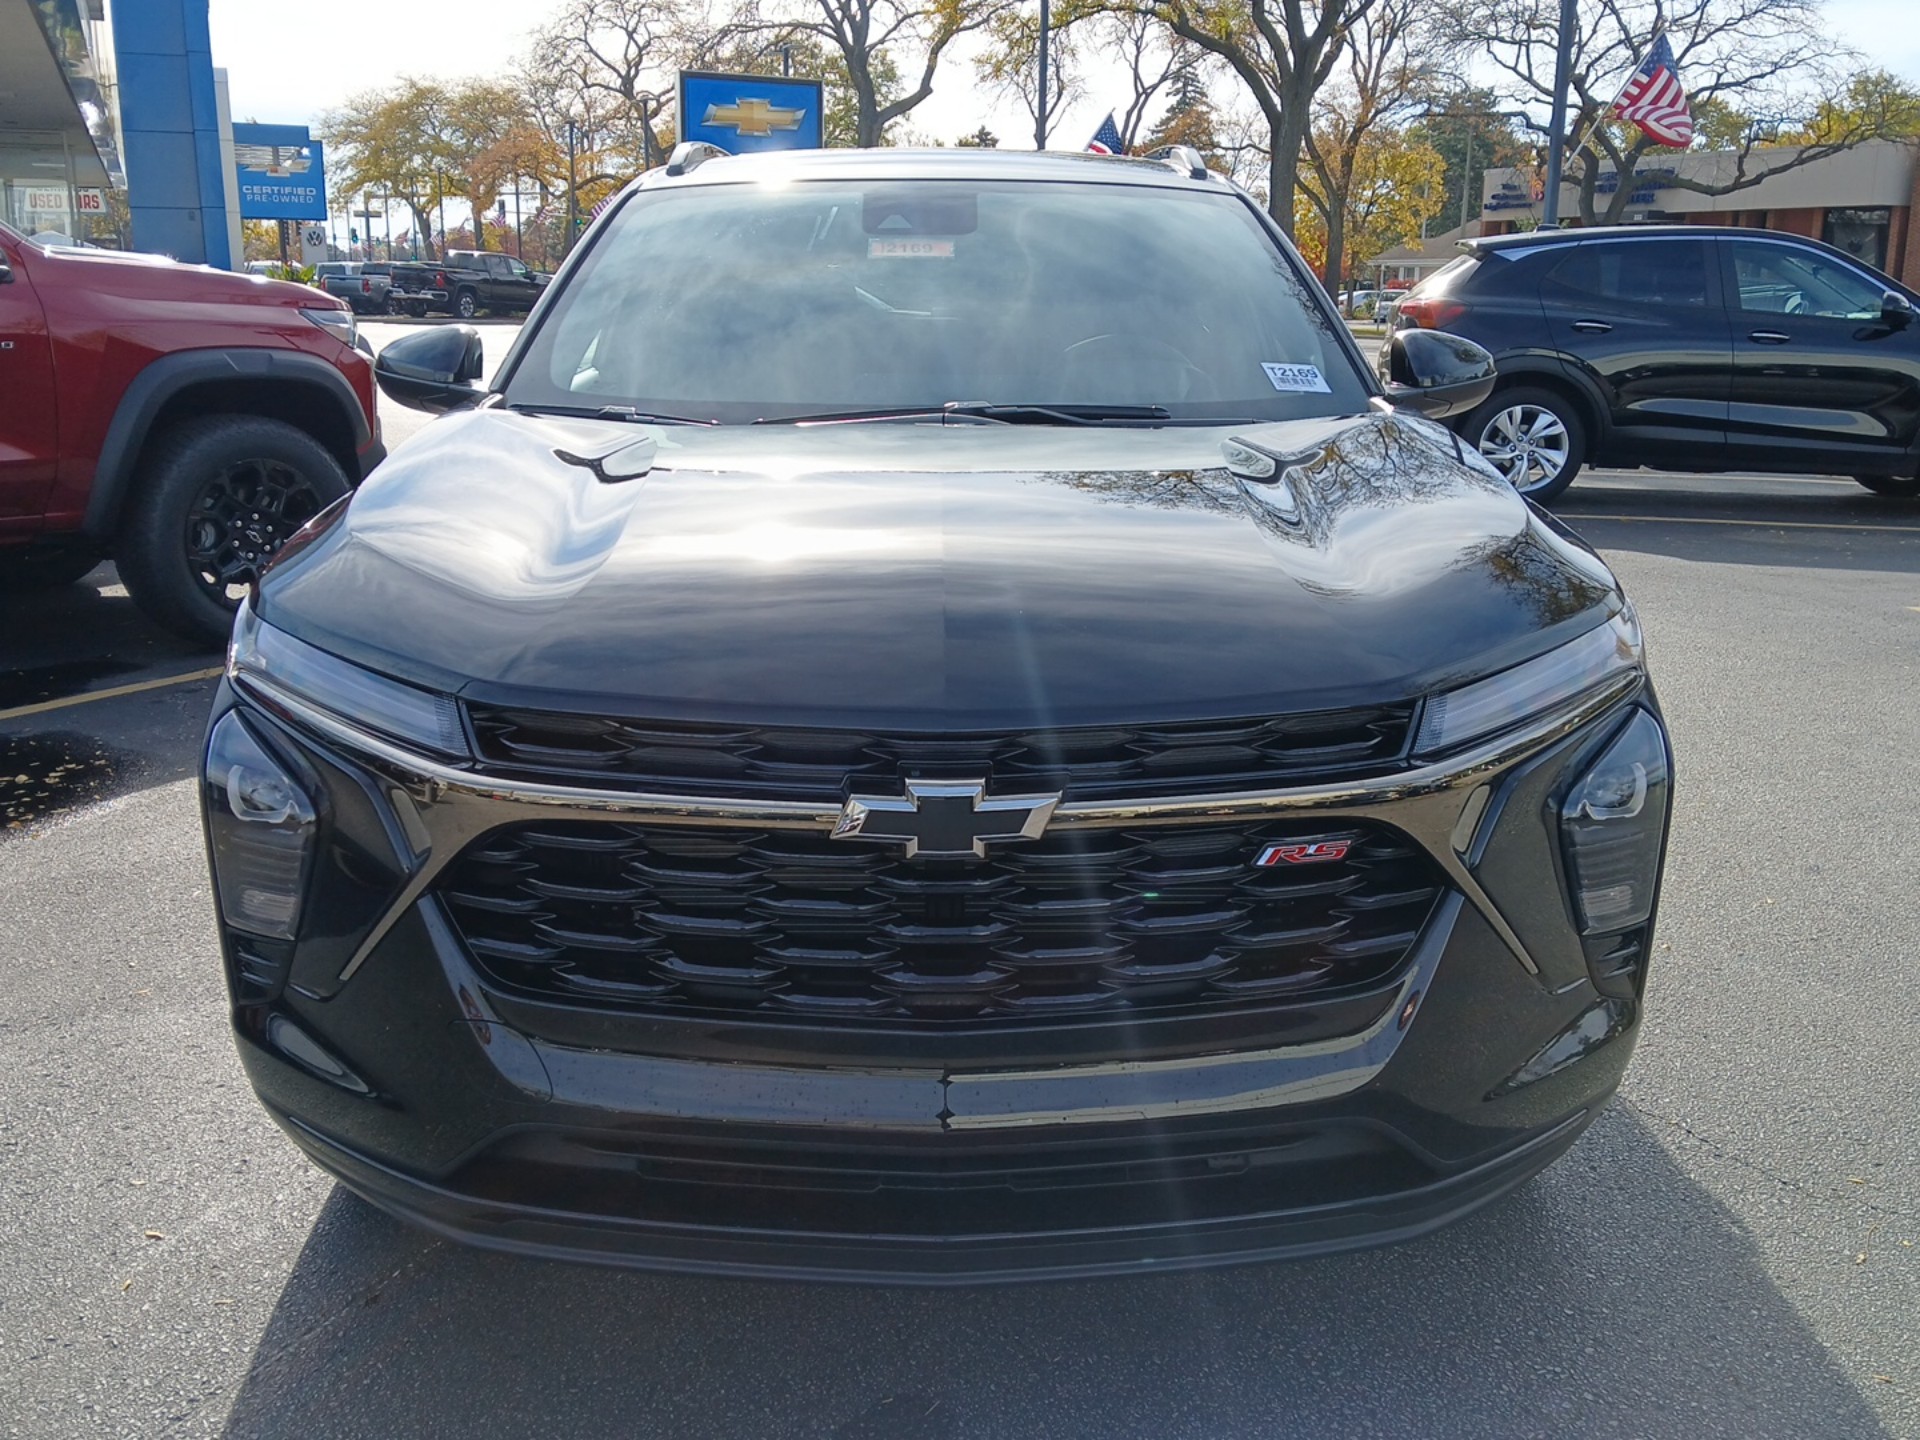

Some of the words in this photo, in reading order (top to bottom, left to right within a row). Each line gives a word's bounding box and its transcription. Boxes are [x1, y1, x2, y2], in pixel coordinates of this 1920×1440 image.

[243, 185, 317, 196] CERTIFIED
[29, 192, 63, 209] USED
[246, 194, 314, 204] PRE-OWNED
[1267, 366, 1318, 378] T2169
[1256, 839, 1351, 865] RS
